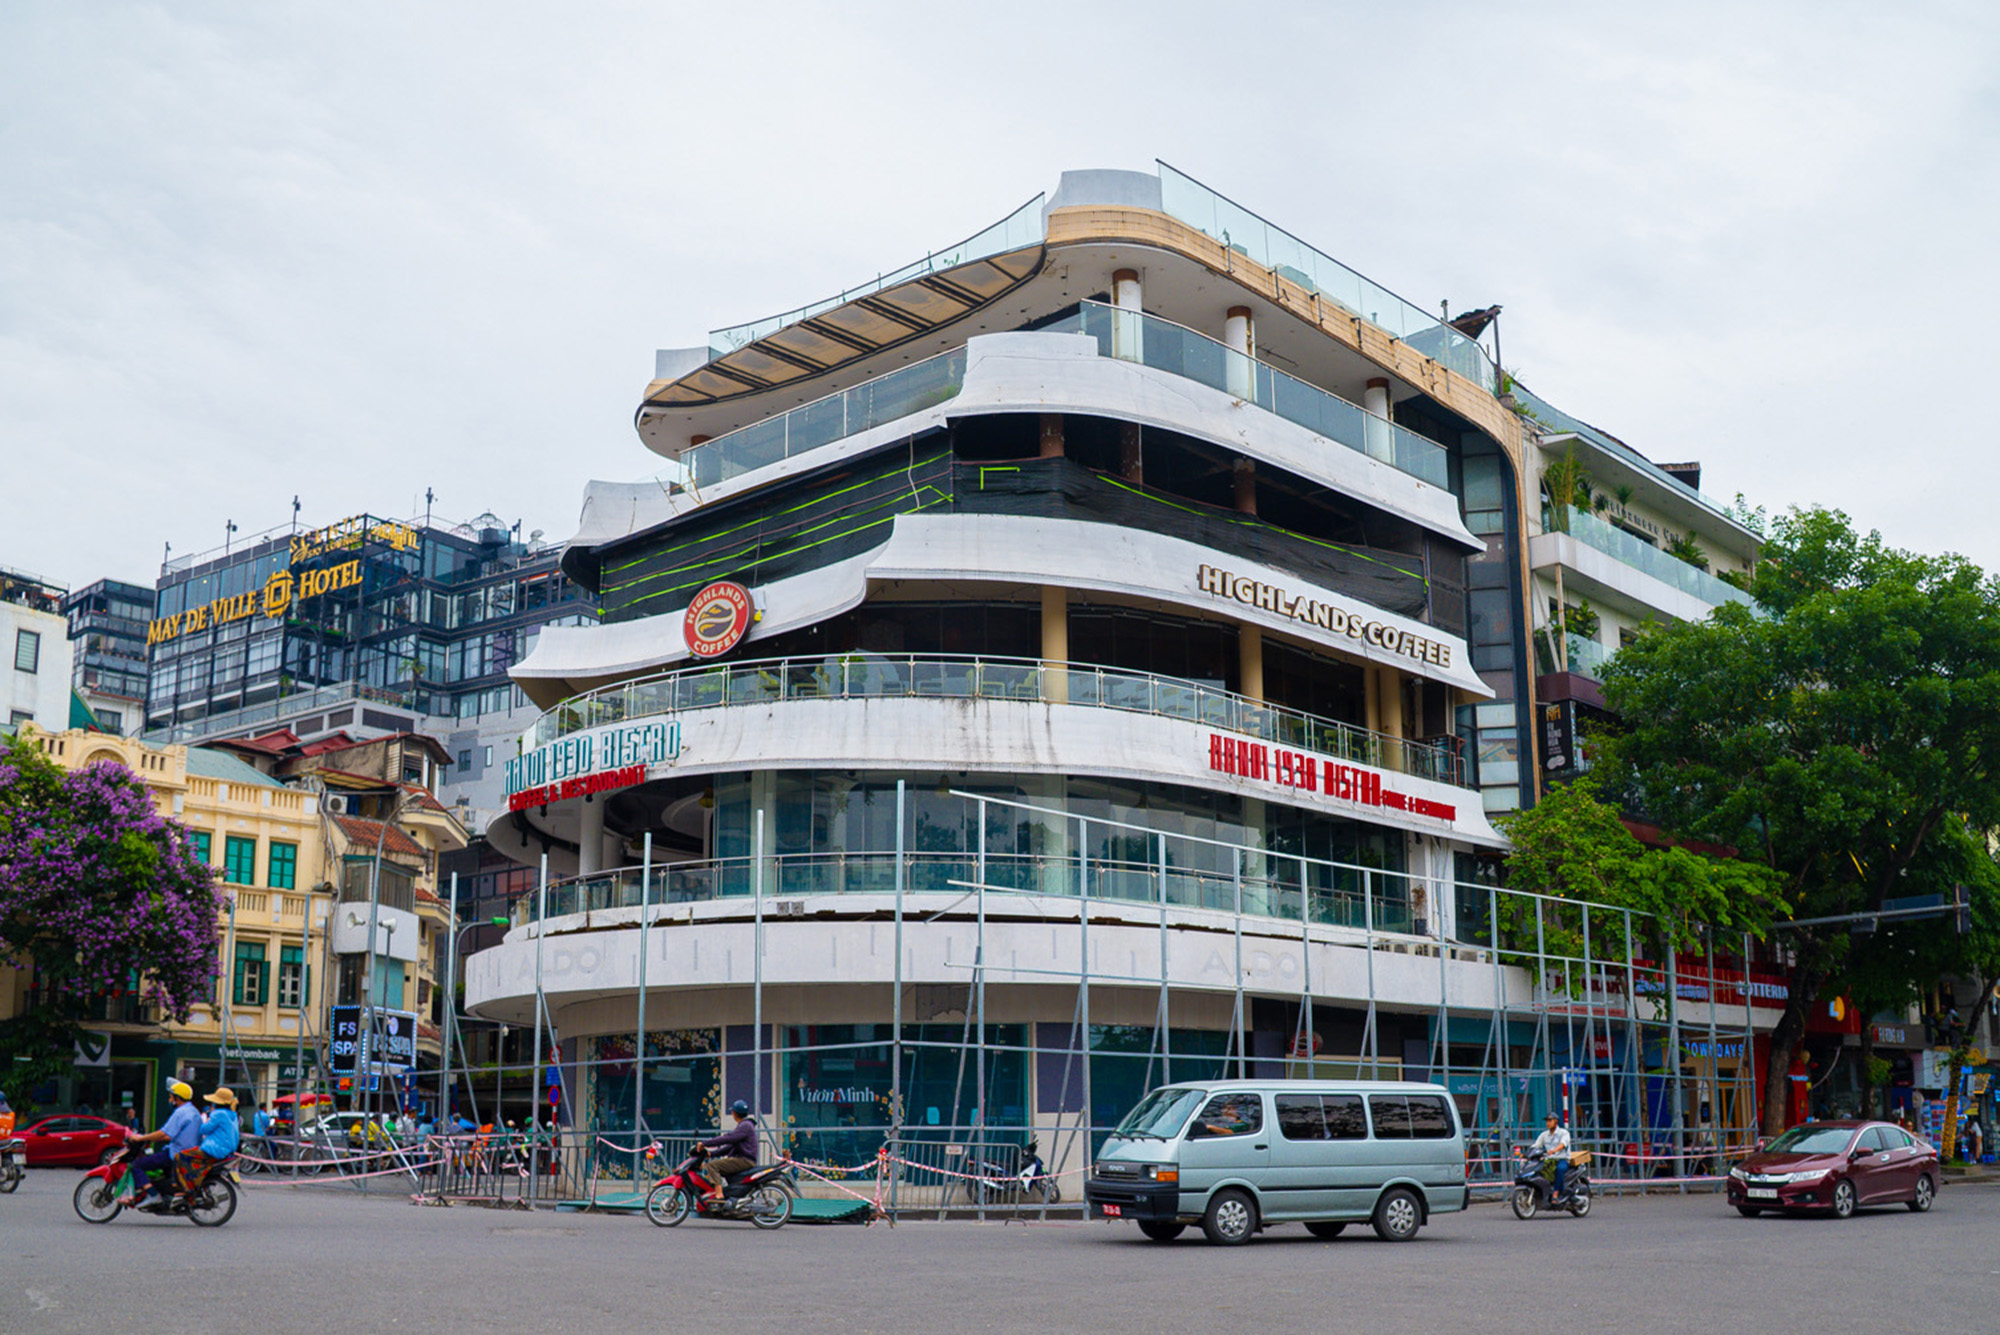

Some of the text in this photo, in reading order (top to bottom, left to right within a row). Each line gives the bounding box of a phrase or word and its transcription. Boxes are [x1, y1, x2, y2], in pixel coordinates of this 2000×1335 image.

[147, 560, 362, 645] MAY DE VILLE HOTEL
[687, 586, 745, 653] HIGHLANDS COFFEE
[1199, 564, 1451, 668] HIGHLANDS COFFEE
[504, 720, 680, 796] HANOI 1930 BISTRO
[1210, 734, 1269, 781] HANOI
[1275, 749, 1317, 791] 1930
[1323, 761, 1381, 806] BISTRO
[509, 764, 646, 812] COFFEE & RESTAURANT
[1201, 947, 1300, 979] ADO
[335, 1041, 358, 1055] SPA
[339, 1022, 356, 1036] FS
[389, 1036, 411, 1055] SPA
[284, 1067, 304, 1076] AT
